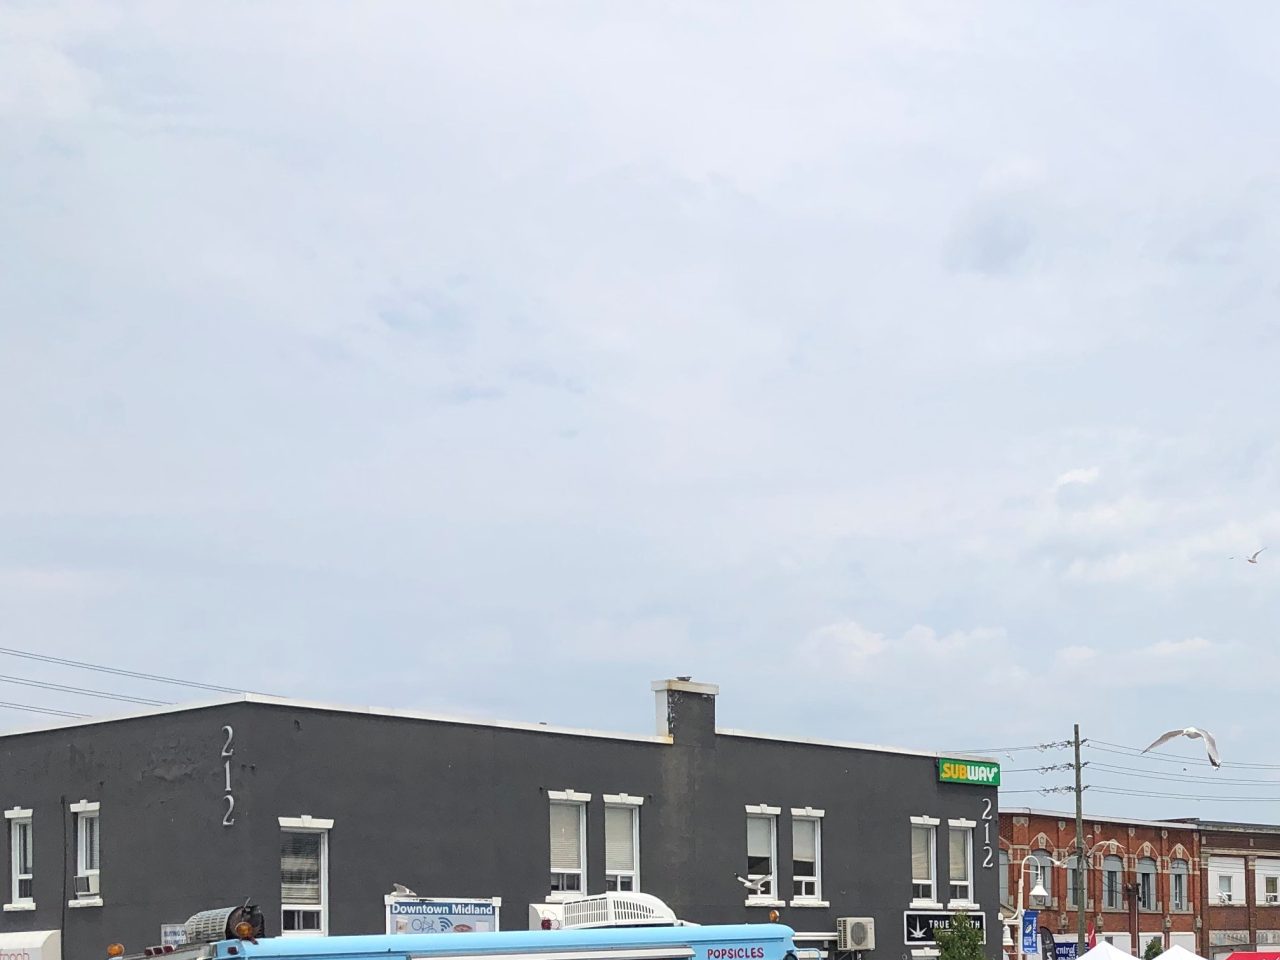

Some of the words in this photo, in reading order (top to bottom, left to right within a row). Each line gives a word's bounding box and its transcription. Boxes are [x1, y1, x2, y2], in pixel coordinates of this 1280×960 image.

[221, 725, 235, 826] 212
[941, 762, 998, 782] SUBWAY
[982, 798, 994, 868] 212
[392, 903, 449, 914] Downtown
[452, 904, 493, 915] Midland
[929, 920, 950, 929] TRUE
[952, 919, 980, 929] RTH
[707, 947, 765, 960] POPSICLES
